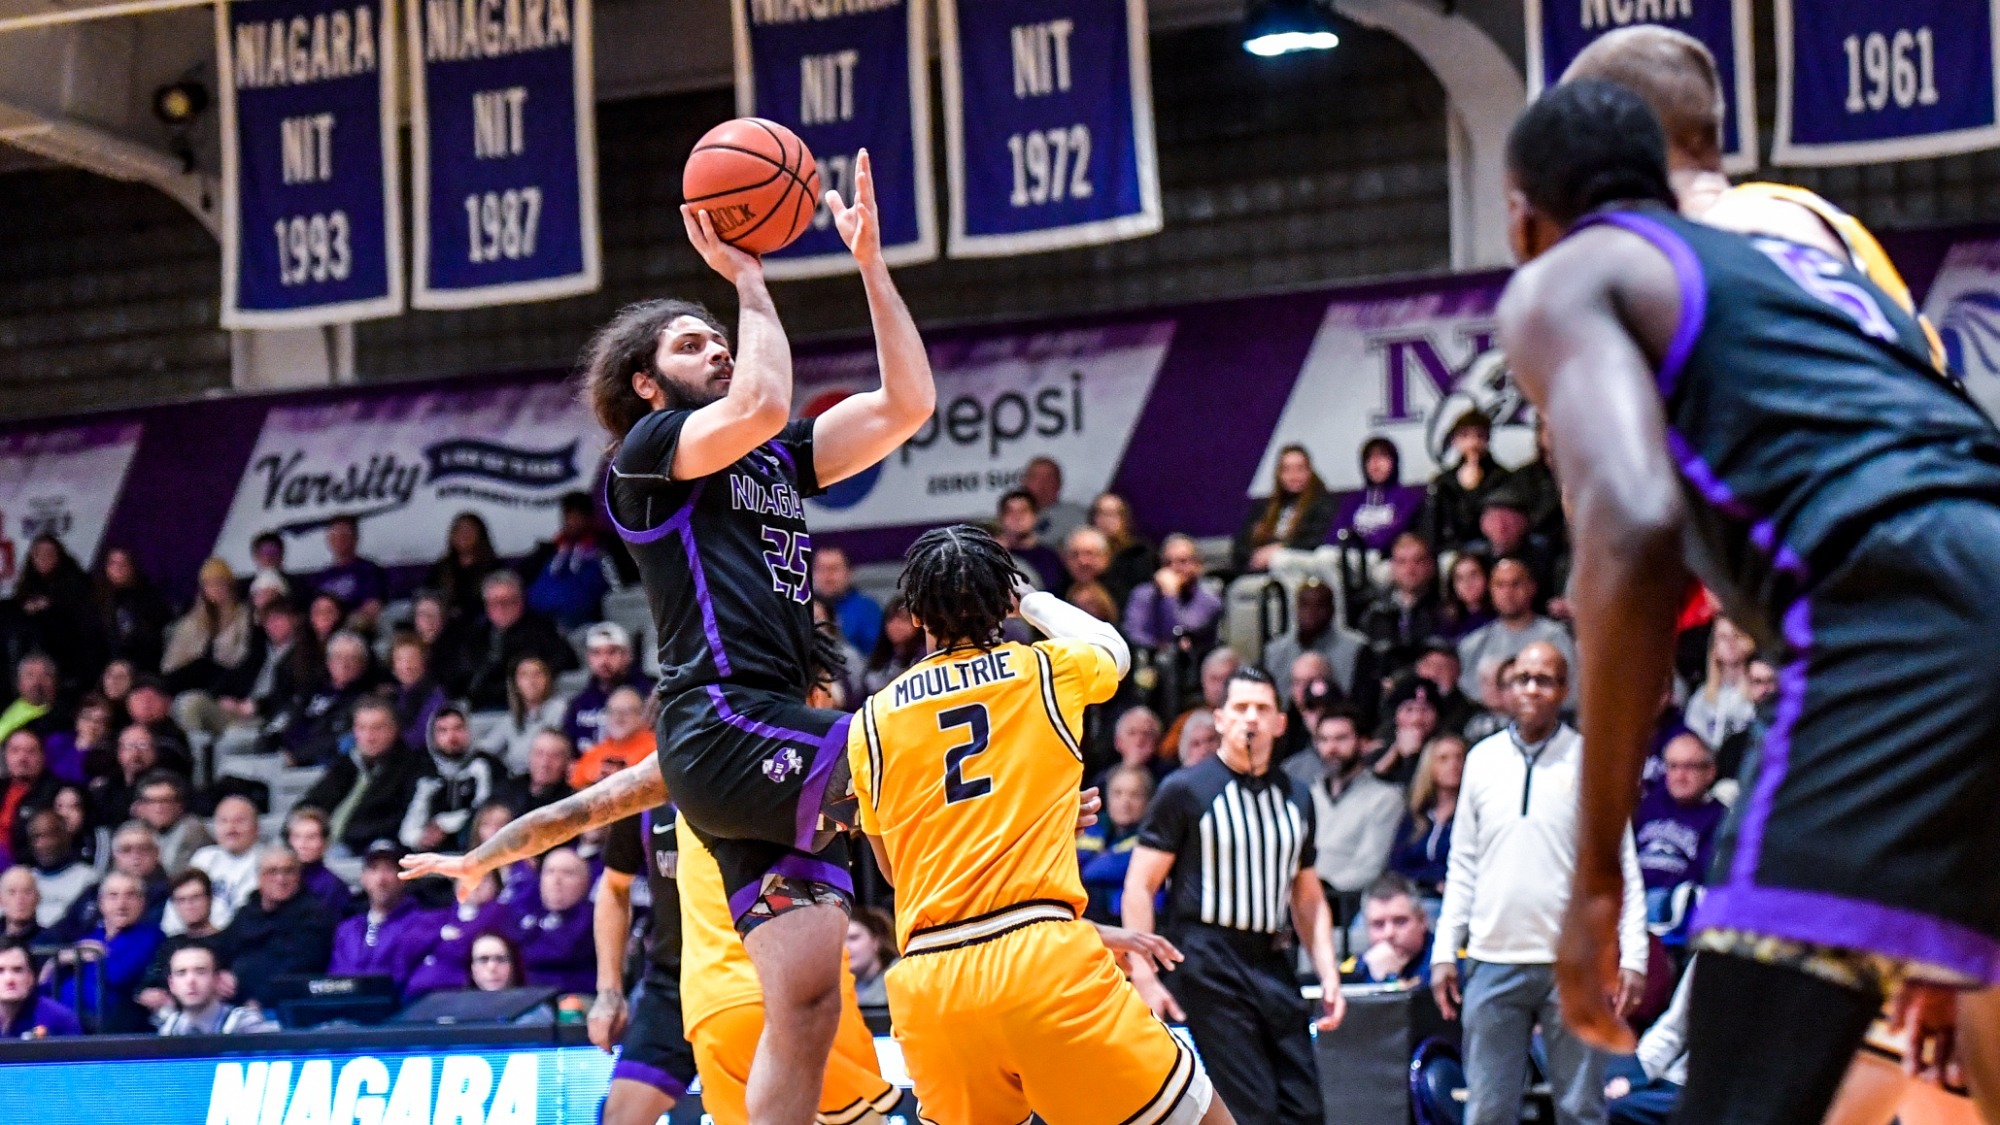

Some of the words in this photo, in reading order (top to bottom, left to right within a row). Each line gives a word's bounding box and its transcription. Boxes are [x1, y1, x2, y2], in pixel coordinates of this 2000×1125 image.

[235, 5, 375, 88] NIAGARA
[426, 0, 569, 62] NIAGARA
[1011, 19, 1073, 98] NIT
[1844, 26, 1938, 113] 1961
[472, 87, 527, 158] NIT
[802, 49, 858, 126] NIT
[280, 112, 334, 184] NIT
[1008, 124, 1093, 207] 1972
[274, 210, 350, 285] 1993
[465, 186, 542, 263] 1987
[255, 448, 421, 512] Varsity
[761, 524, 812, 605] 25
[895, 651, 1016, 708] MOULTRIE
[937, 701, 993, 807] 2
[206, 1053, 538, 1125] NIAGARA
